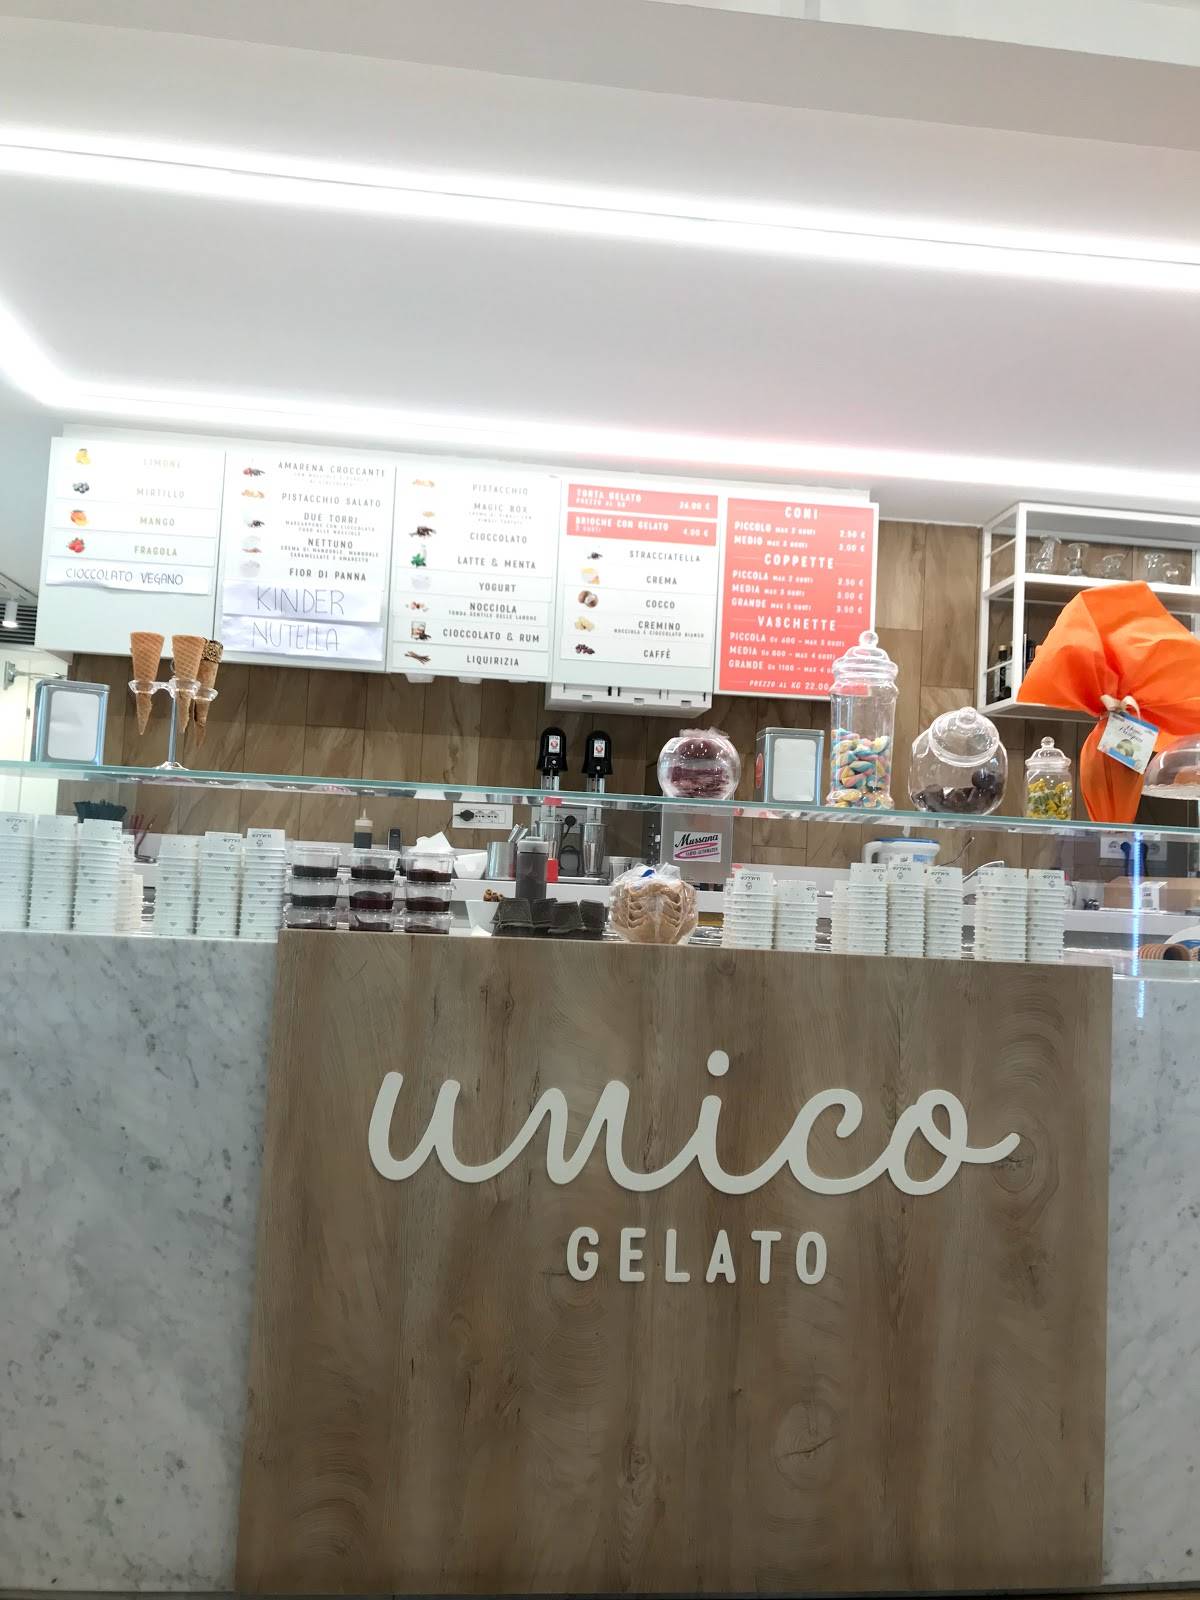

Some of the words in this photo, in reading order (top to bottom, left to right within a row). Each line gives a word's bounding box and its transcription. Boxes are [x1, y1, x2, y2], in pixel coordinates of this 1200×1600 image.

[278, 462, 324, 473] AMARENA
[137, 488, 185, 499] MIRTILLO
[472, 484, 528, 495] PISTACCHIO
[282, 493, 340, 504] PISTACCHIO
[346, 497, 381, 508] SALATO
[609, 492, 642, 502] GELATO
[705, 502, 711, 511] €
[474, 503, 504, 513] MAGIC
[510, 505, 528, 514] BOX
[784, 507, 819, 520] CONI
[140, 517, 175, 526] MANGO
[304, 512, 322, 521] DUE
[329, 514, 358, 524] TORRI
[575, 516, 612, 528] BRIOCHE
[617, 519, 633, 529] CON
[638, 521, 669, 531] GELATO
[703, 529, 709, 538] €
[734, 521, 772, 533] PICCOLO
[860, 531, 866, 539] €
[308, 538, 353, 549] NETTUNO
[470, 532, 528, 544] CIOCCOLATO
[734, 536, 763, 546] MEDIO
[860, 544, 865, 552] €
[134, 546, 177, 556] FRAGOLA
[630, 550, 701, 562] STRACCIATELLA
[458, 556, 485, 566] LATTE
[505, 560, 536, 569] MENTA
[764, 553, 834, 569] COPPETTE
[66, 568, 132, 582] CIOCCOLATO
[141, 572, 183, 585] VEGANO
[290, 568, 312, 578] FIOR
[319, 570, 329, 579] DI
[335, 571, 367, 581] PANNA
[646, 576, 678, 585] CREMA
[732, 570, 769, 581] PICCOLA
[480, 582, 516, 592] YOGURT
[732, 584, 760, 594] MEDIA
[837, 591, 855, 600] 3.00
[858, 592, 864, 601] €
[256, 585, 345, 615] KINDER
[646, 600, 675, 609] COCCO
[731, 597, 766, 609] GRANDE
[857, 606, 863, 614] €
[470, 602, 517, 614] NOCCIOLA
[638, 621, 681, 631] CREMINO
[757, 615, 837, 632] VASCHETTE
[252, 621, 340, 651] NUTELLA
[443, 629, 501, 640] CIOCCOLATO
[507, 632, 514, 641] &
[520, 633, 540, 642] RUM
[730, 632, 766, 643] PICCOLA
[729, 646, 757, 656] MEDIA
[467, 655, 519, 666] LIQUIRIZIA
[729, 659, 763, 670] GRANDE
[750, 679, 775, 688] PREZZO
[804, 682, 829, 691] 22.00
[675, 833, 718, 848] Mussana
[368, 1050, 1020, 1196] unico
[566, 1225, 828, 1286] GELATO
